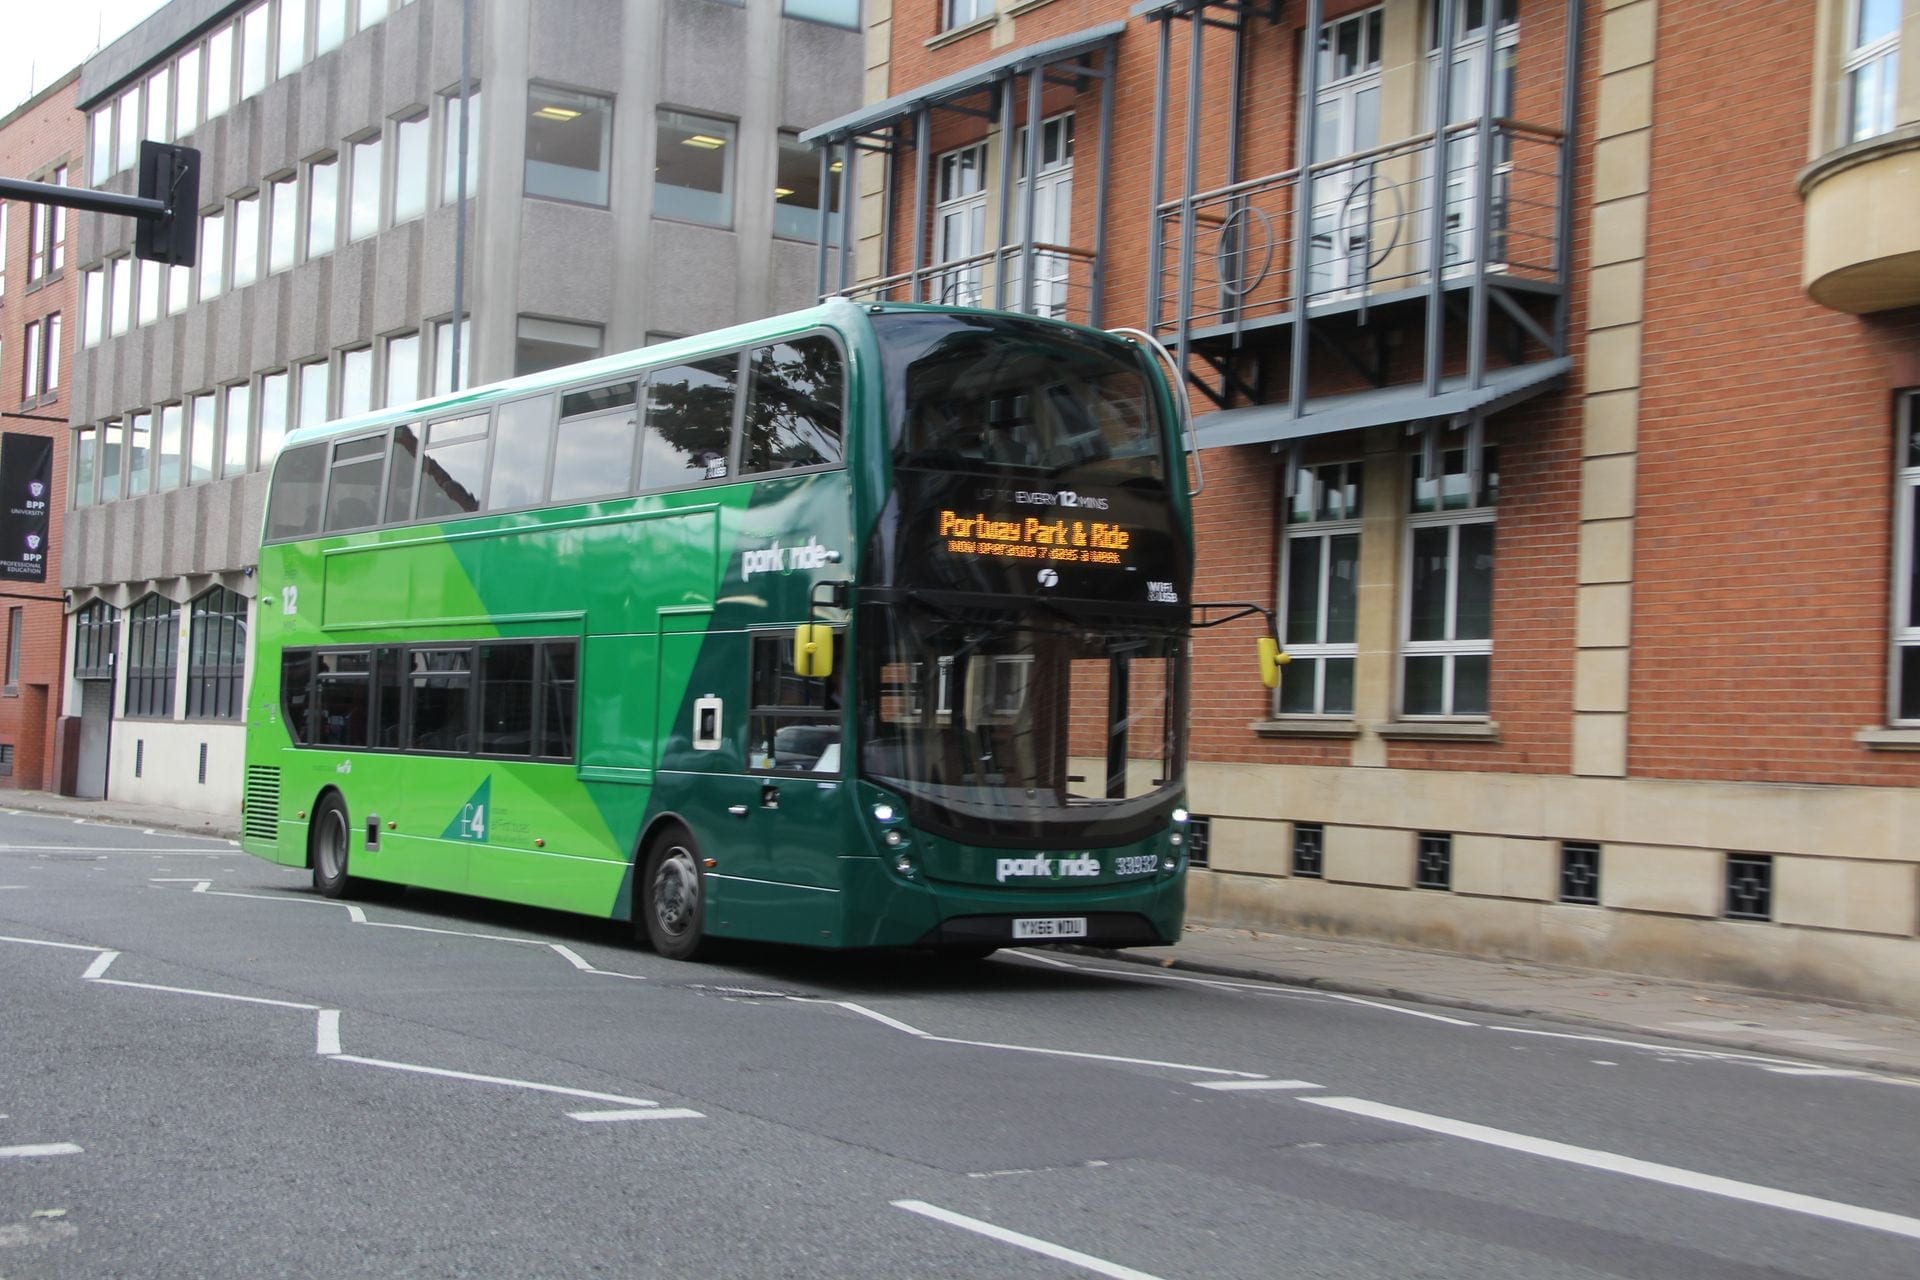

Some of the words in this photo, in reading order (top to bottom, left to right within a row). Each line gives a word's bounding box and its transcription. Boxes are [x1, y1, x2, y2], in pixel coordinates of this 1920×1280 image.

[26, 500, 45, 509] BPP
[1015, 491, 1056, 506] EVERY
[1057, 490, 1078, 507] 12
[1078, 496, 1109, 510] MINS
[11, 508, 44, 516] UNIVERSITY
[940, 510, 1021, 541] Portway
[1022, 517, 1067, 545] Park
[1071, 521, 1087, 547] &
[1090, 522, 1130, 550] Ride
[23, 553, 42, 562] BPP
[1037, 547, 1048, 559] 7
[0, 560, 41, 568] PROFESSIONAL
[7, 566, 41, 574] EDUCATION
[282, 585, 298, 615] 12
[460, 802, 485, 839] £4
[1115, 854, 1158, 875] 33932
[1020, 920, 1054, 935] YX66
